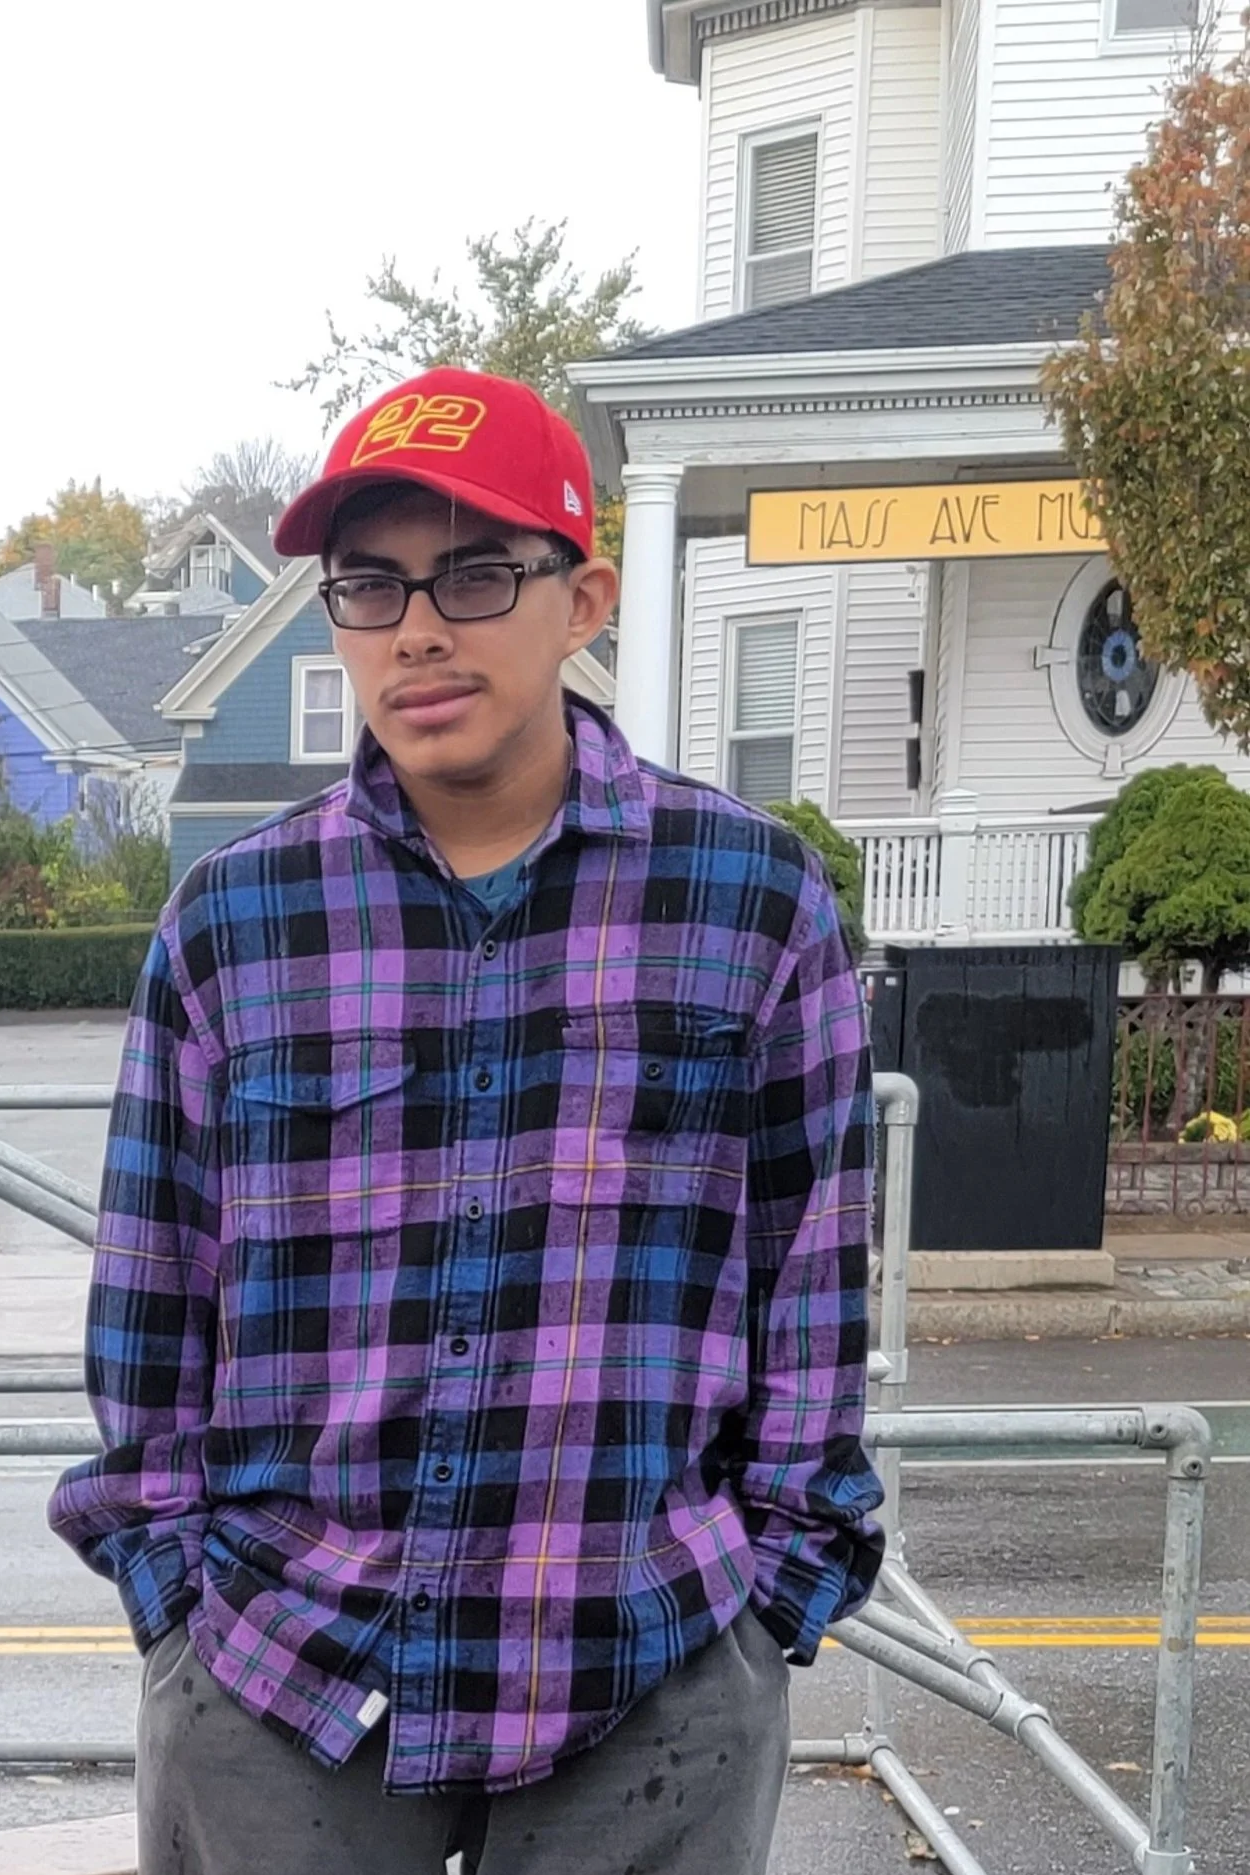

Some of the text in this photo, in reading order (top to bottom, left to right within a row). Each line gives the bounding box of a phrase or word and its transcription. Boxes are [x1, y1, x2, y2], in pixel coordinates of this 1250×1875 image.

[350, 393, 487, 467] 22
[798, 491, 1104, 550] MASS AVE MU
